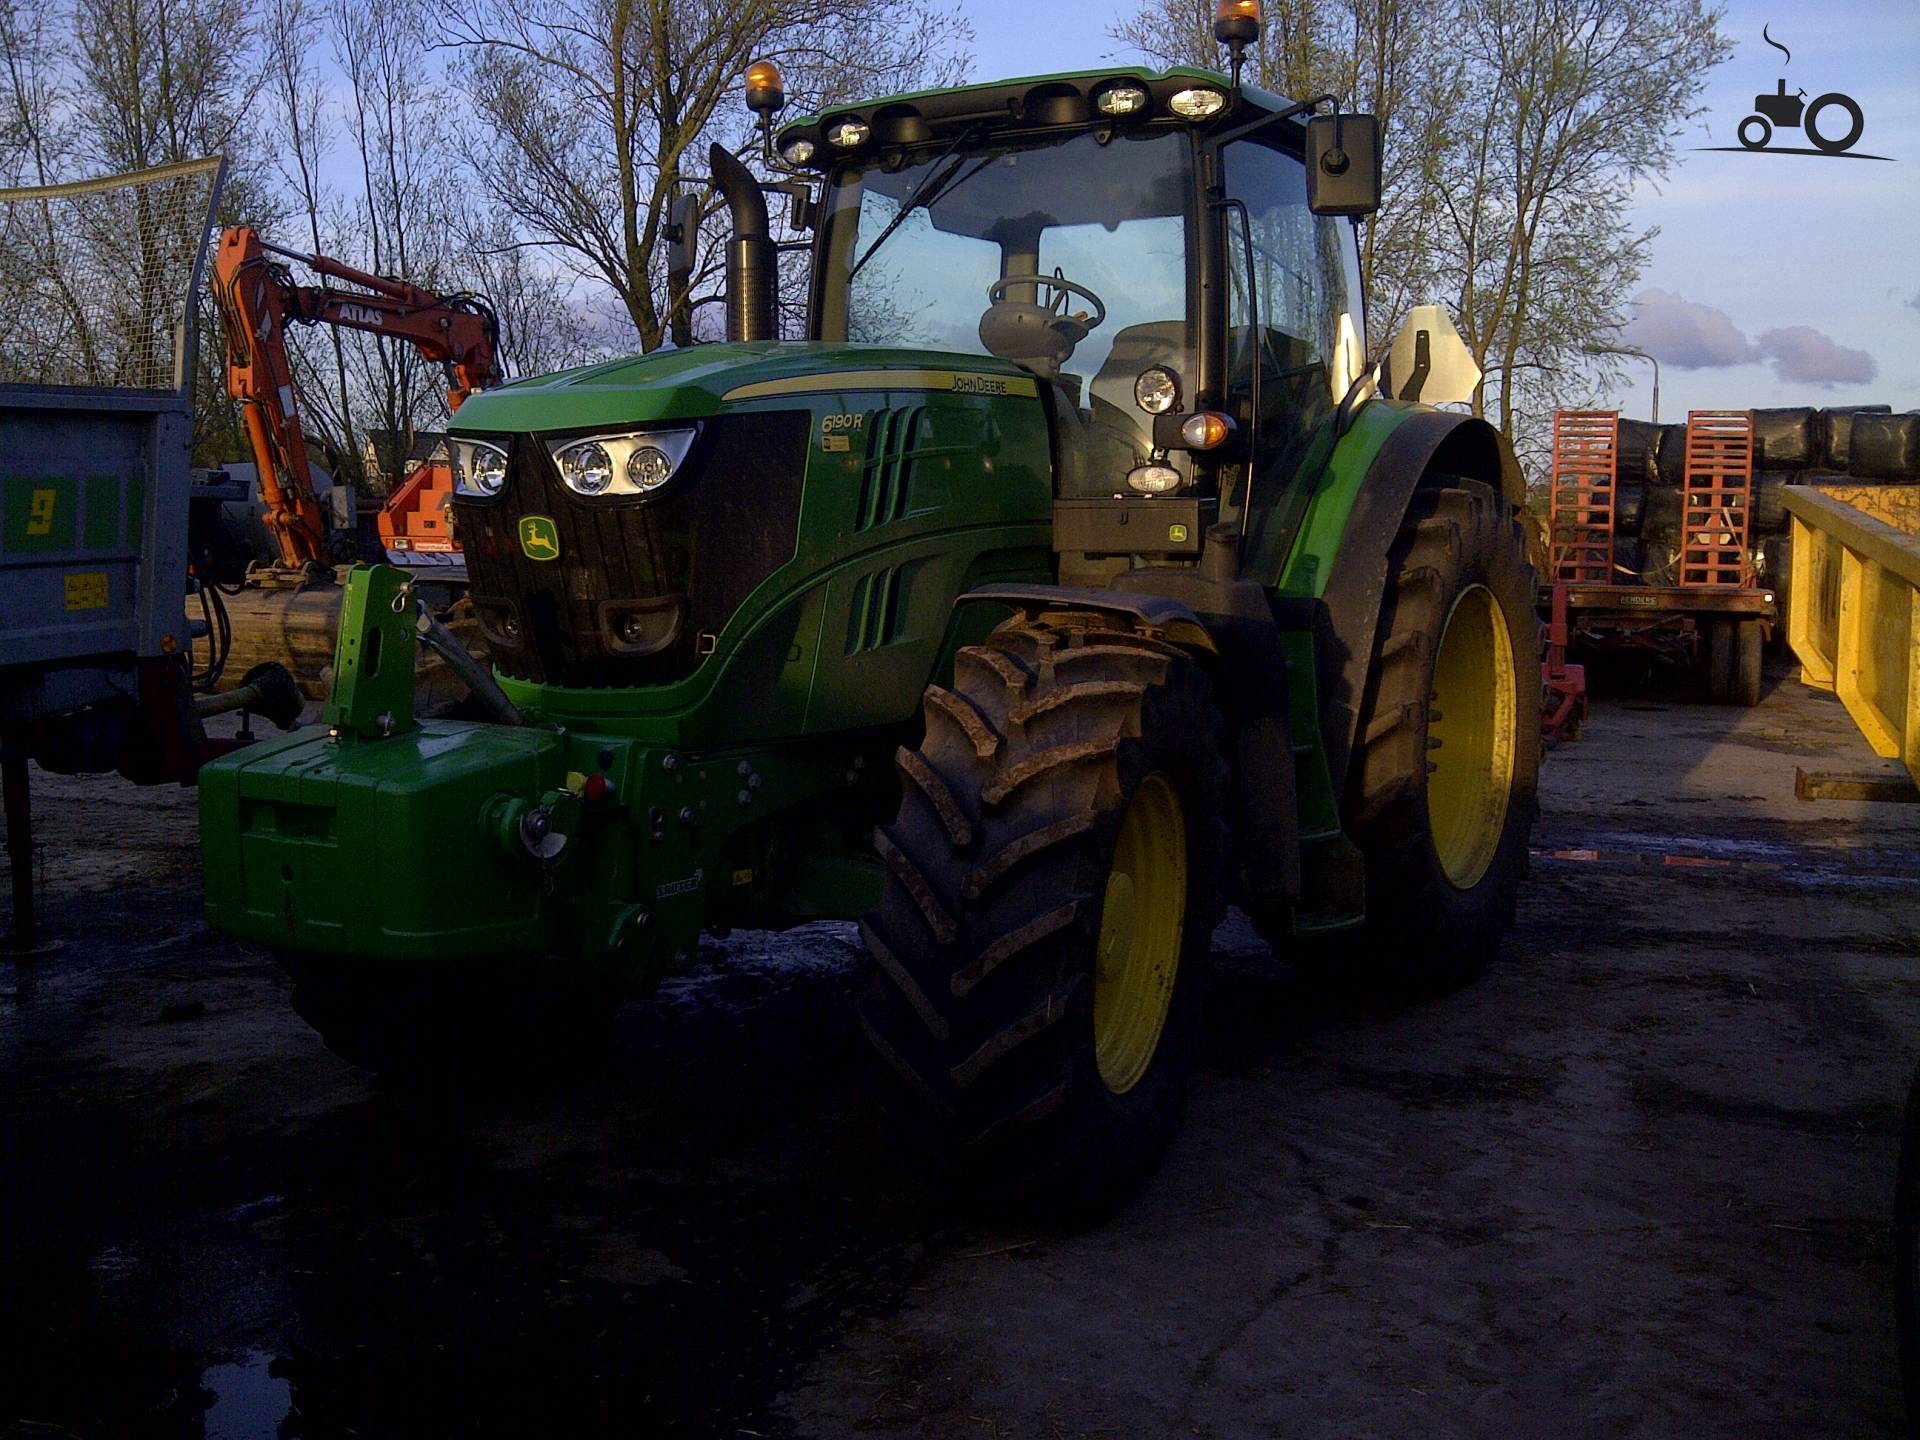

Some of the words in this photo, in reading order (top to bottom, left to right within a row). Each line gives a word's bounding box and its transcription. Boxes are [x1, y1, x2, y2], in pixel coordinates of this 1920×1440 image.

[339, 303, 384, 326] ATLAS
[952, 375, 976, 392] JOHN
[977, 376, 1007, 394] DEERE
